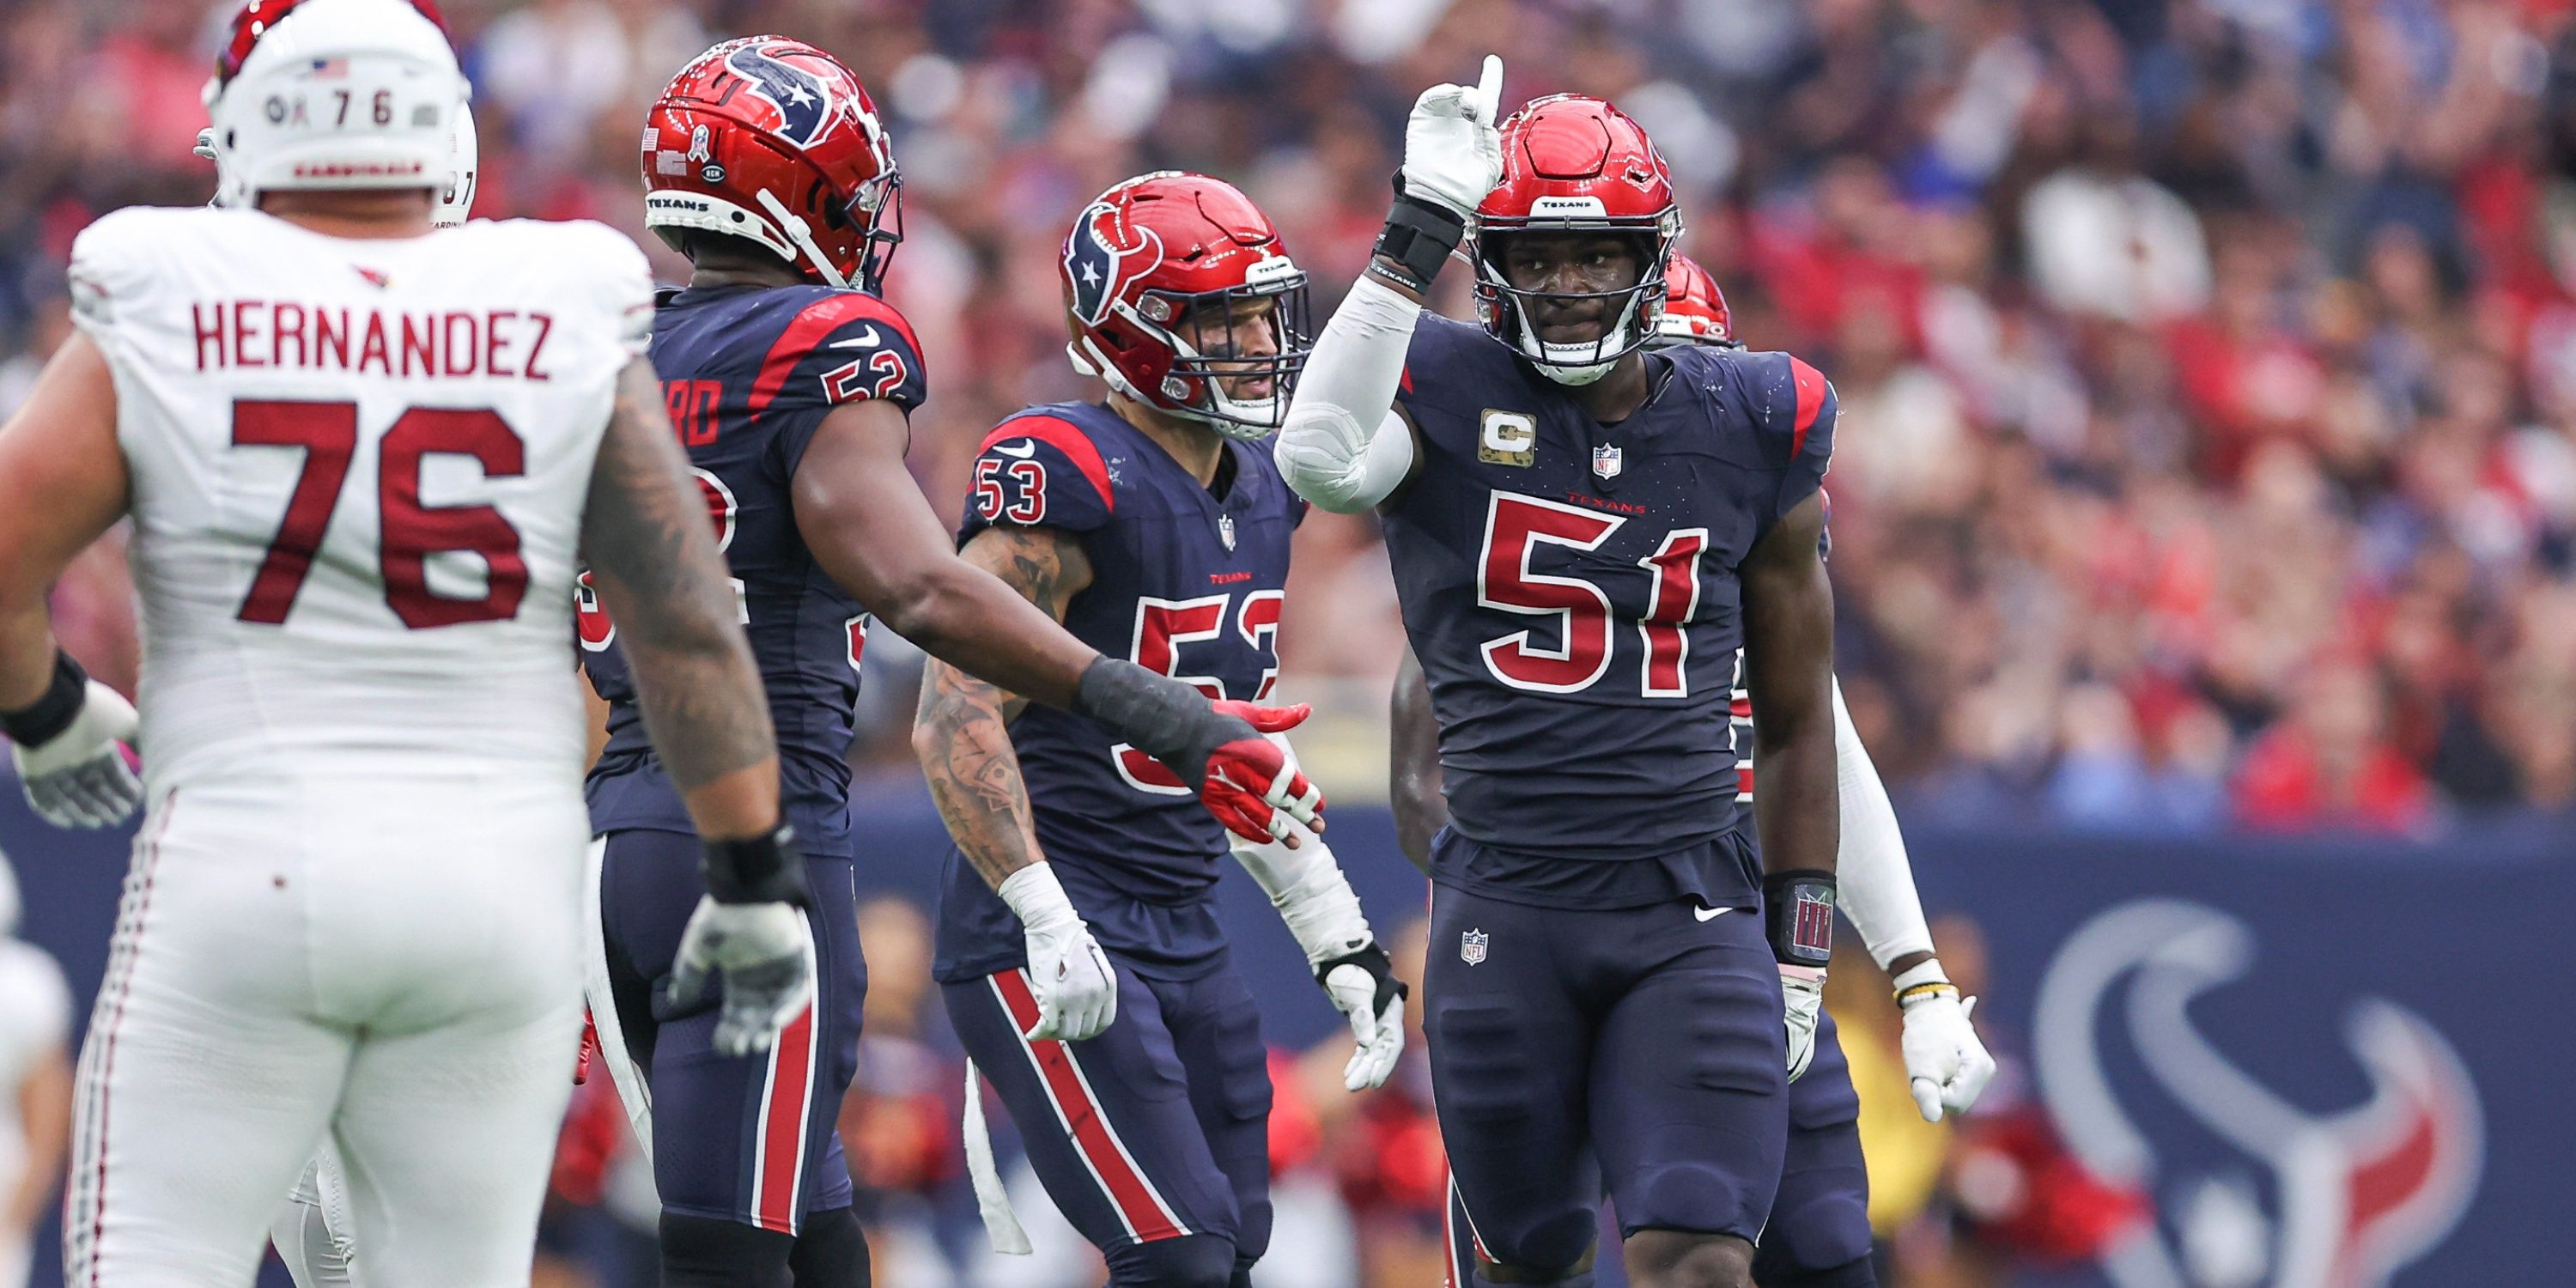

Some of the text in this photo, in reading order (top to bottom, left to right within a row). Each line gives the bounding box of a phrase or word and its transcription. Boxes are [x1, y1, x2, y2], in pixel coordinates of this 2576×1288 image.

[335, 89, 392, 126] 76
[647, 198, 709, 211] TEXANS
[1376, 266, 1417, 288] TEXANS
[191, 301, 555, 380] HERNANDEZ
[659, 379, 723, 447] RD
[1484, 412, 1533, 453] C
[1596, 458, 1618, 471] NFL
[975, 459, 1048, 525] 53
[1566, 490, 1647, 514] TEXANS
[232, 398, 530, 629] 76
[1477, 489, 1709, 698] 51
[1465, 945, 1482, 958] NFL
